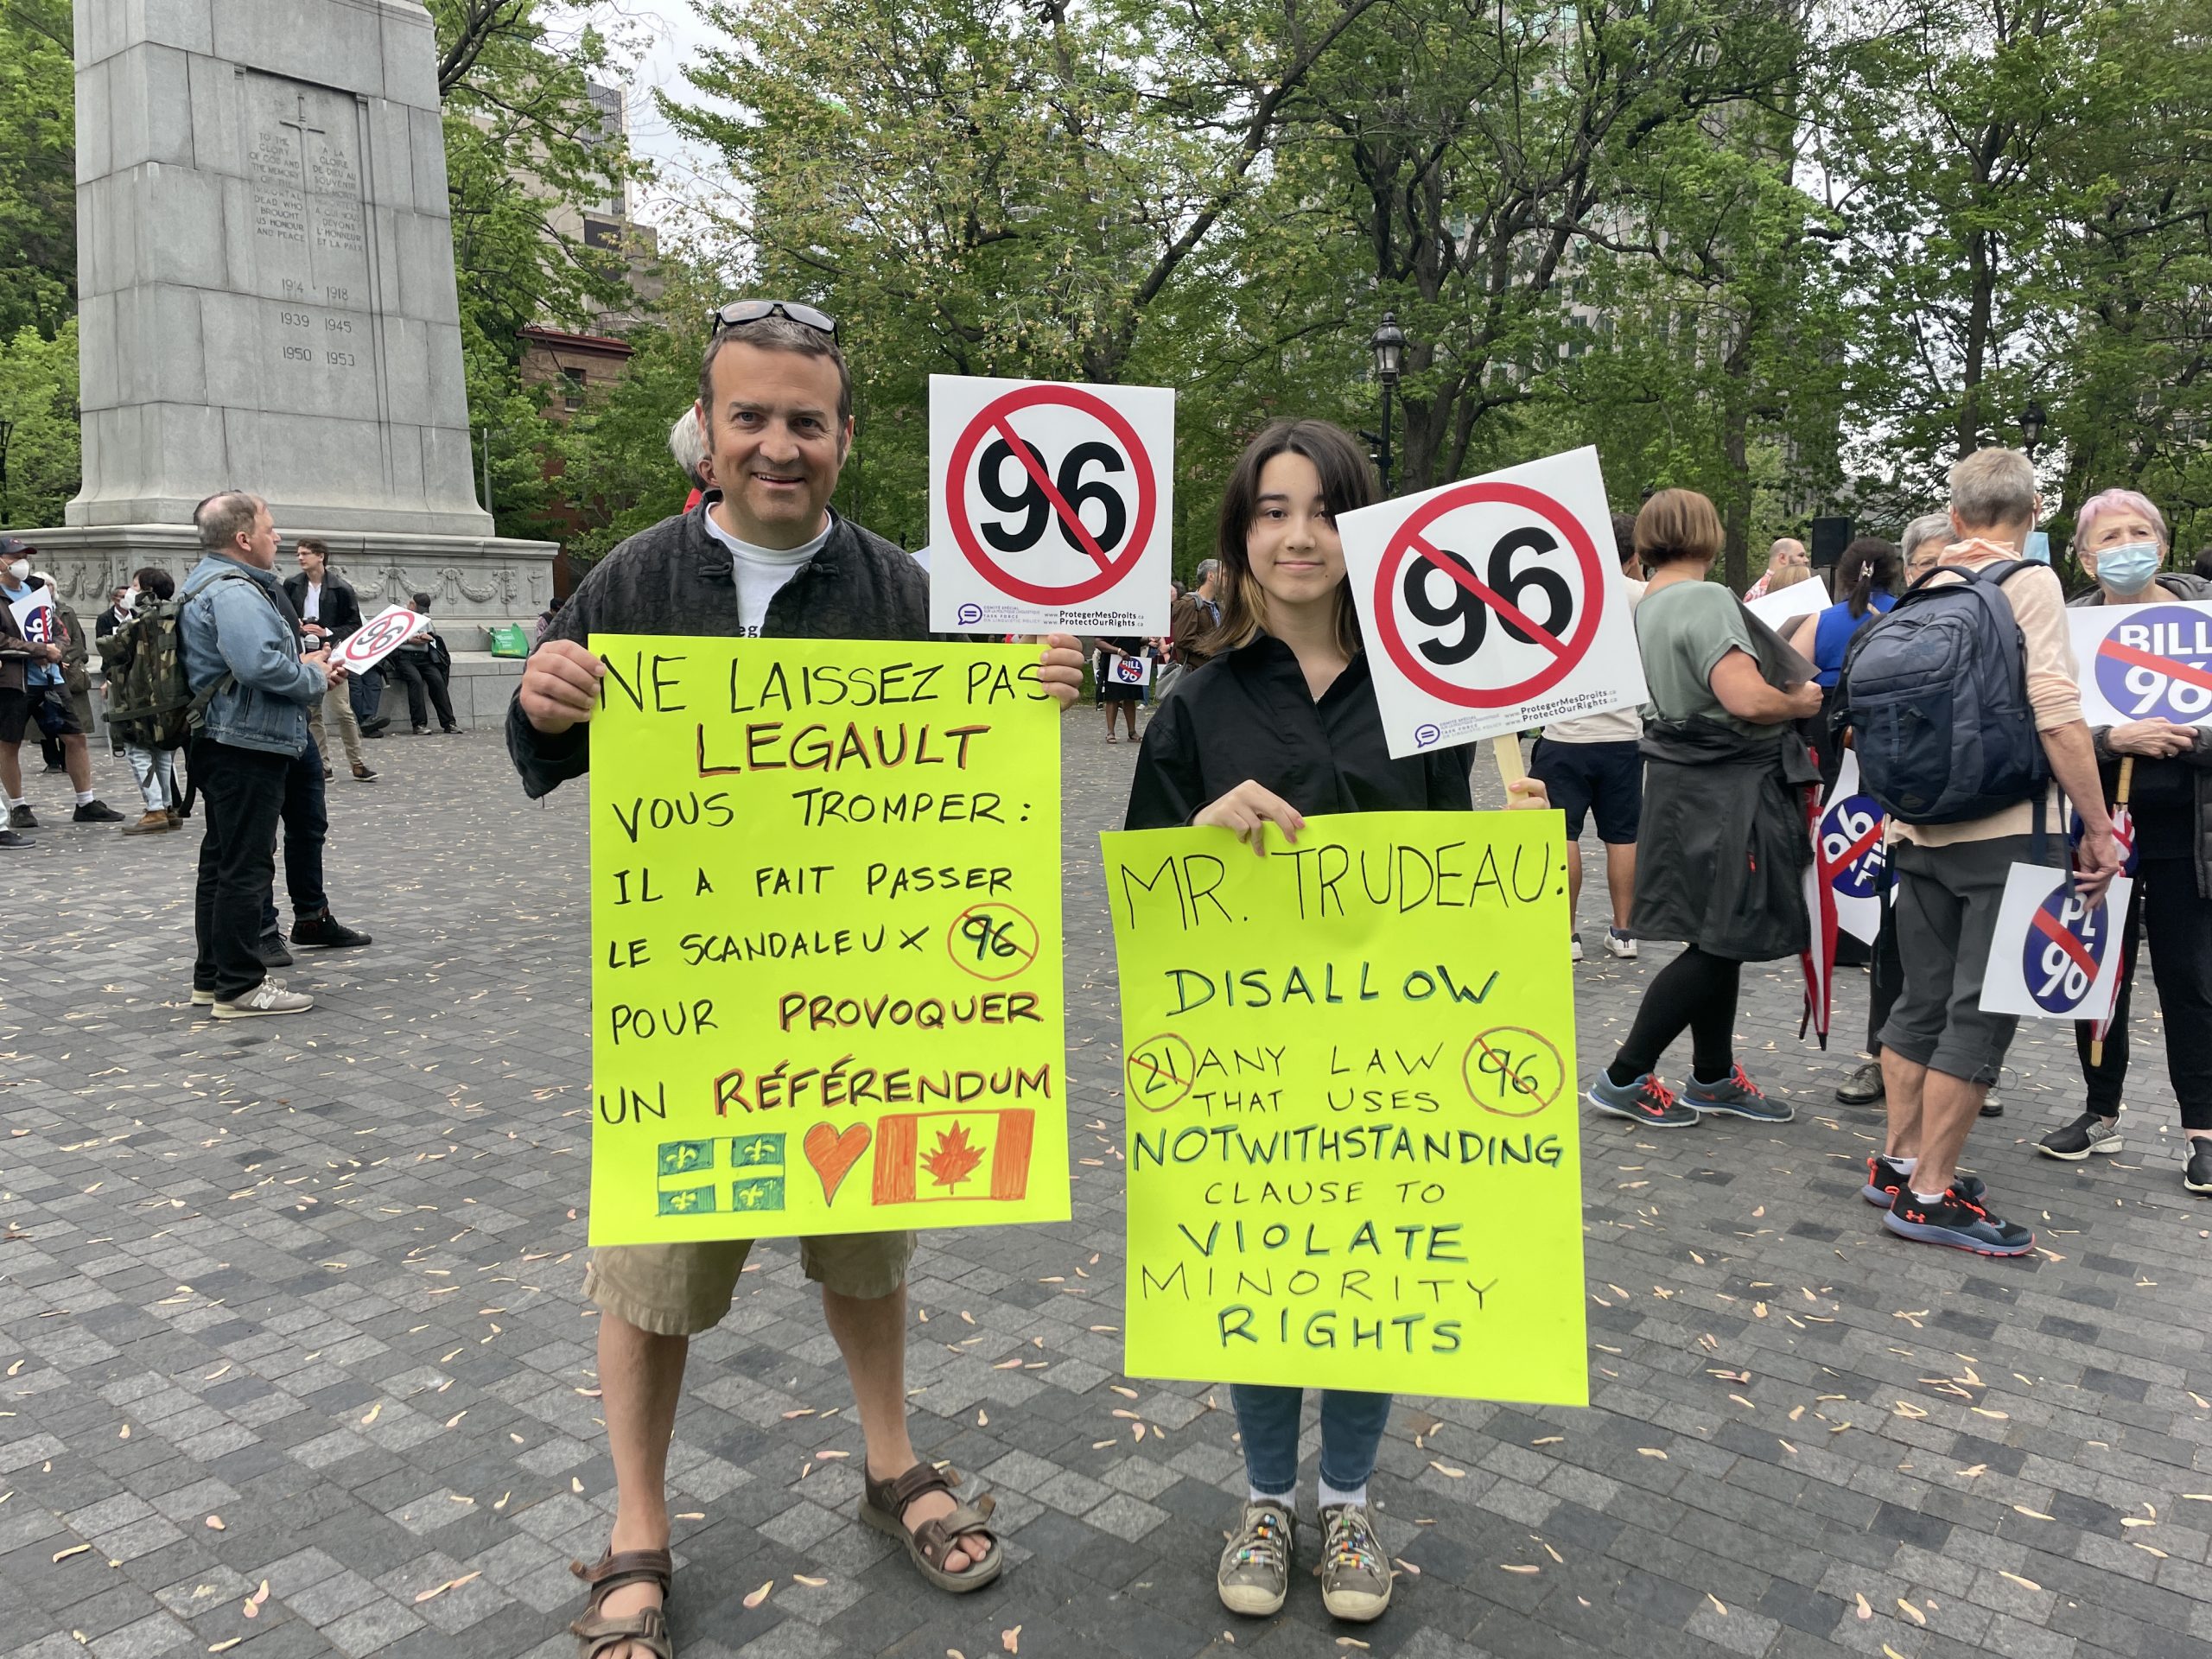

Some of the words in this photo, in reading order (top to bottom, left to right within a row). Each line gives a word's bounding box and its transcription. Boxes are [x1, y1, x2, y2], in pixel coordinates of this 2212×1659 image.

[313, 164, 323, 174] DE
[254, 194, 277, 207] DEAD
[283, 200, 302, 211] WHO
[256, 216, 266, 226] US
[270, 218, 305, 232] HONOUR
[260, 207, 299, 220] BROUGHT
[322, 218, 356, 231] DEVONS
[257, 227, 274, 237] AND
[277, 230, 306, 243] PEACE
[317, 237, 326, 246] ET
[330, 239, 340, 248] LA
[327, 285, 349, 302] 1918
[281, 311, 309, 327] 1939
[325, 317, 352, 334] 1945
[283, 346, 312, 361] 1950
[327, 351, 355, 367] 1953
[978, 437, 1127, 555] 96
[1403, 526, 1573, 665] 96
[356, 621, 404, 651] 96
[2120, 621, 2212, 656] BILL
[599, 651, 689, 713] NE
[730, 657, 944, 714] LAISSEZ
[967, 660, 1052, 705] PAS
[1122, 659, 1141, 670] BILL
[1122, 669, 1138, 681] 96
[2125, 661, 2212, 715] 96
[696, 721, 992, 779] LEGAULT
[612, 792, 734, 843] VOUS
[613, 867, 664, 906] IL
[695, 867, 715, 897] A
[755, 865, 835, 899] FAIT
[867, 863, 1013, 899] PASSER
[1121, 854, 1249, 931] MR.
[1271, 841, 1568, 920] TRUDEAU:
[2060, 892, 2096, 937] PL
[608, 938, 651, 969] LE
[679, 924, 931, 966] SCANDALEUX
[961, 915, 1018, 961] 96
[1165, 960, 1500, 1017] DISALLOW
[2037, 940, 2094, 1001] 96
[612, 998, 719, 1046] POUR
[779, 991, 1044, 1032] PROVOQUER
[601, 1082, 667, 1124] UN
[715, 1053, 1052, 1117] RÉFÉRENDUM
[1137, 1046, 1179, 1094] 21
[1196, 1045, 1287, 1077] ANY
[1331, 1041, 1445, 1076] LAW
[1478, 1048, 1539, 1097] 96
[1193, 1089, 1285, 1117] THAT
[1327, 1089, 1440, 1113] USES
[1132, 1122, 1564, 1171] NOTWITHSTANDING
[1205, 1180, 1364, 1205] CLAUSE
[1396, 1180, 1446, 1205] TO
[1178, 1219, 1469, 1263] VIOLATE
[1141, 1261, 1500, 1311] MINORITY
[1218, 1304, 1463, 1354] RIGHTS
